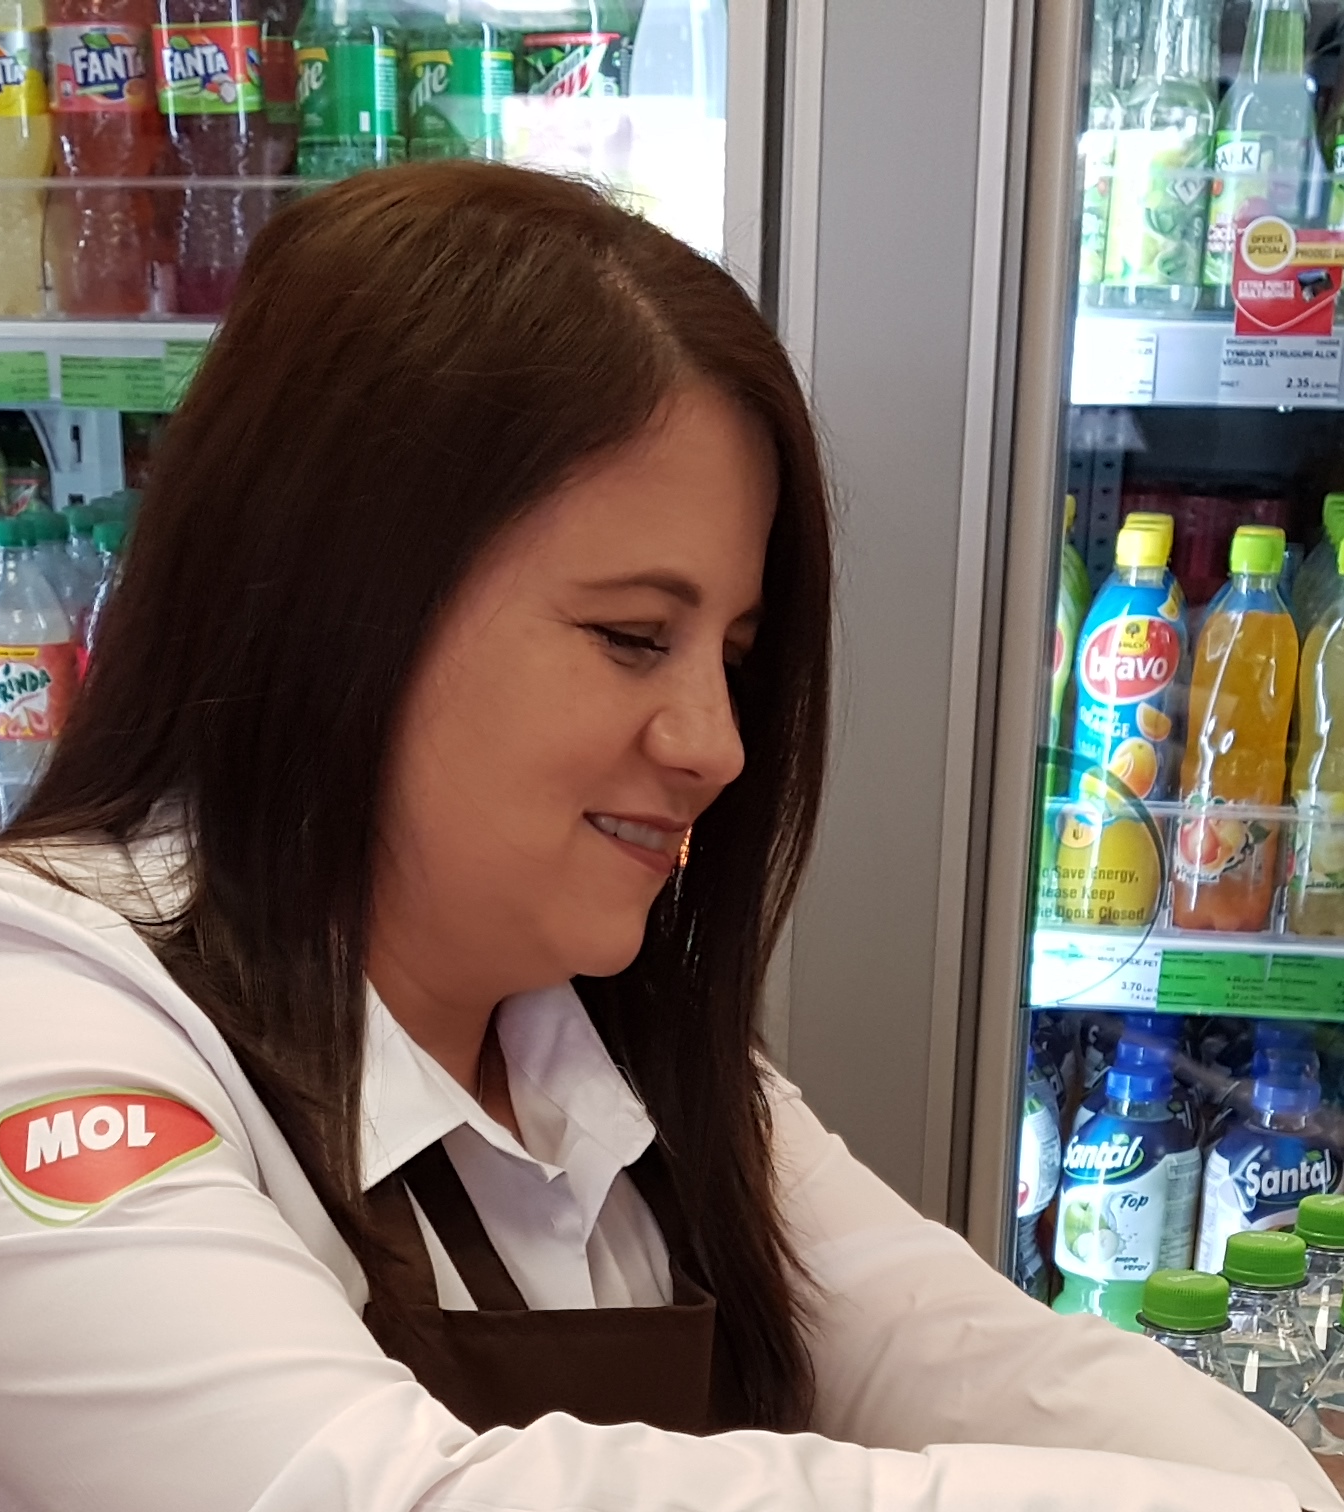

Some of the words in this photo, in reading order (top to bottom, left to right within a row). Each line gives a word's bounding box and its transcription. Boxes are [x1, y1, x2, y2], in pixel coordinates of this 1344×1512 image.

[71, 46, 145, 84] FANTA
[163, 45, 229, 80] FANTA
[1286, 377, 1310, 389] 2.35
[1088, 646, 1169, 681] bravo
[1056, 866, 1086, 879] Save
[1042, 886, 1078, 900] lease
[1082, 886, 1116, 902] Keep
[1057, 906, 1095, 920] Doors
[1099, 907, 1145, 921] Closed
[1121, 981, 1143, 991] 3.70
[25, 1104, 156, 1173] MOL
[1063, 1134, 1145, 1171] Santal
[1244, 1148, 1333, 1197] Santal
[1119, 1193, 1150, 1210] Top
